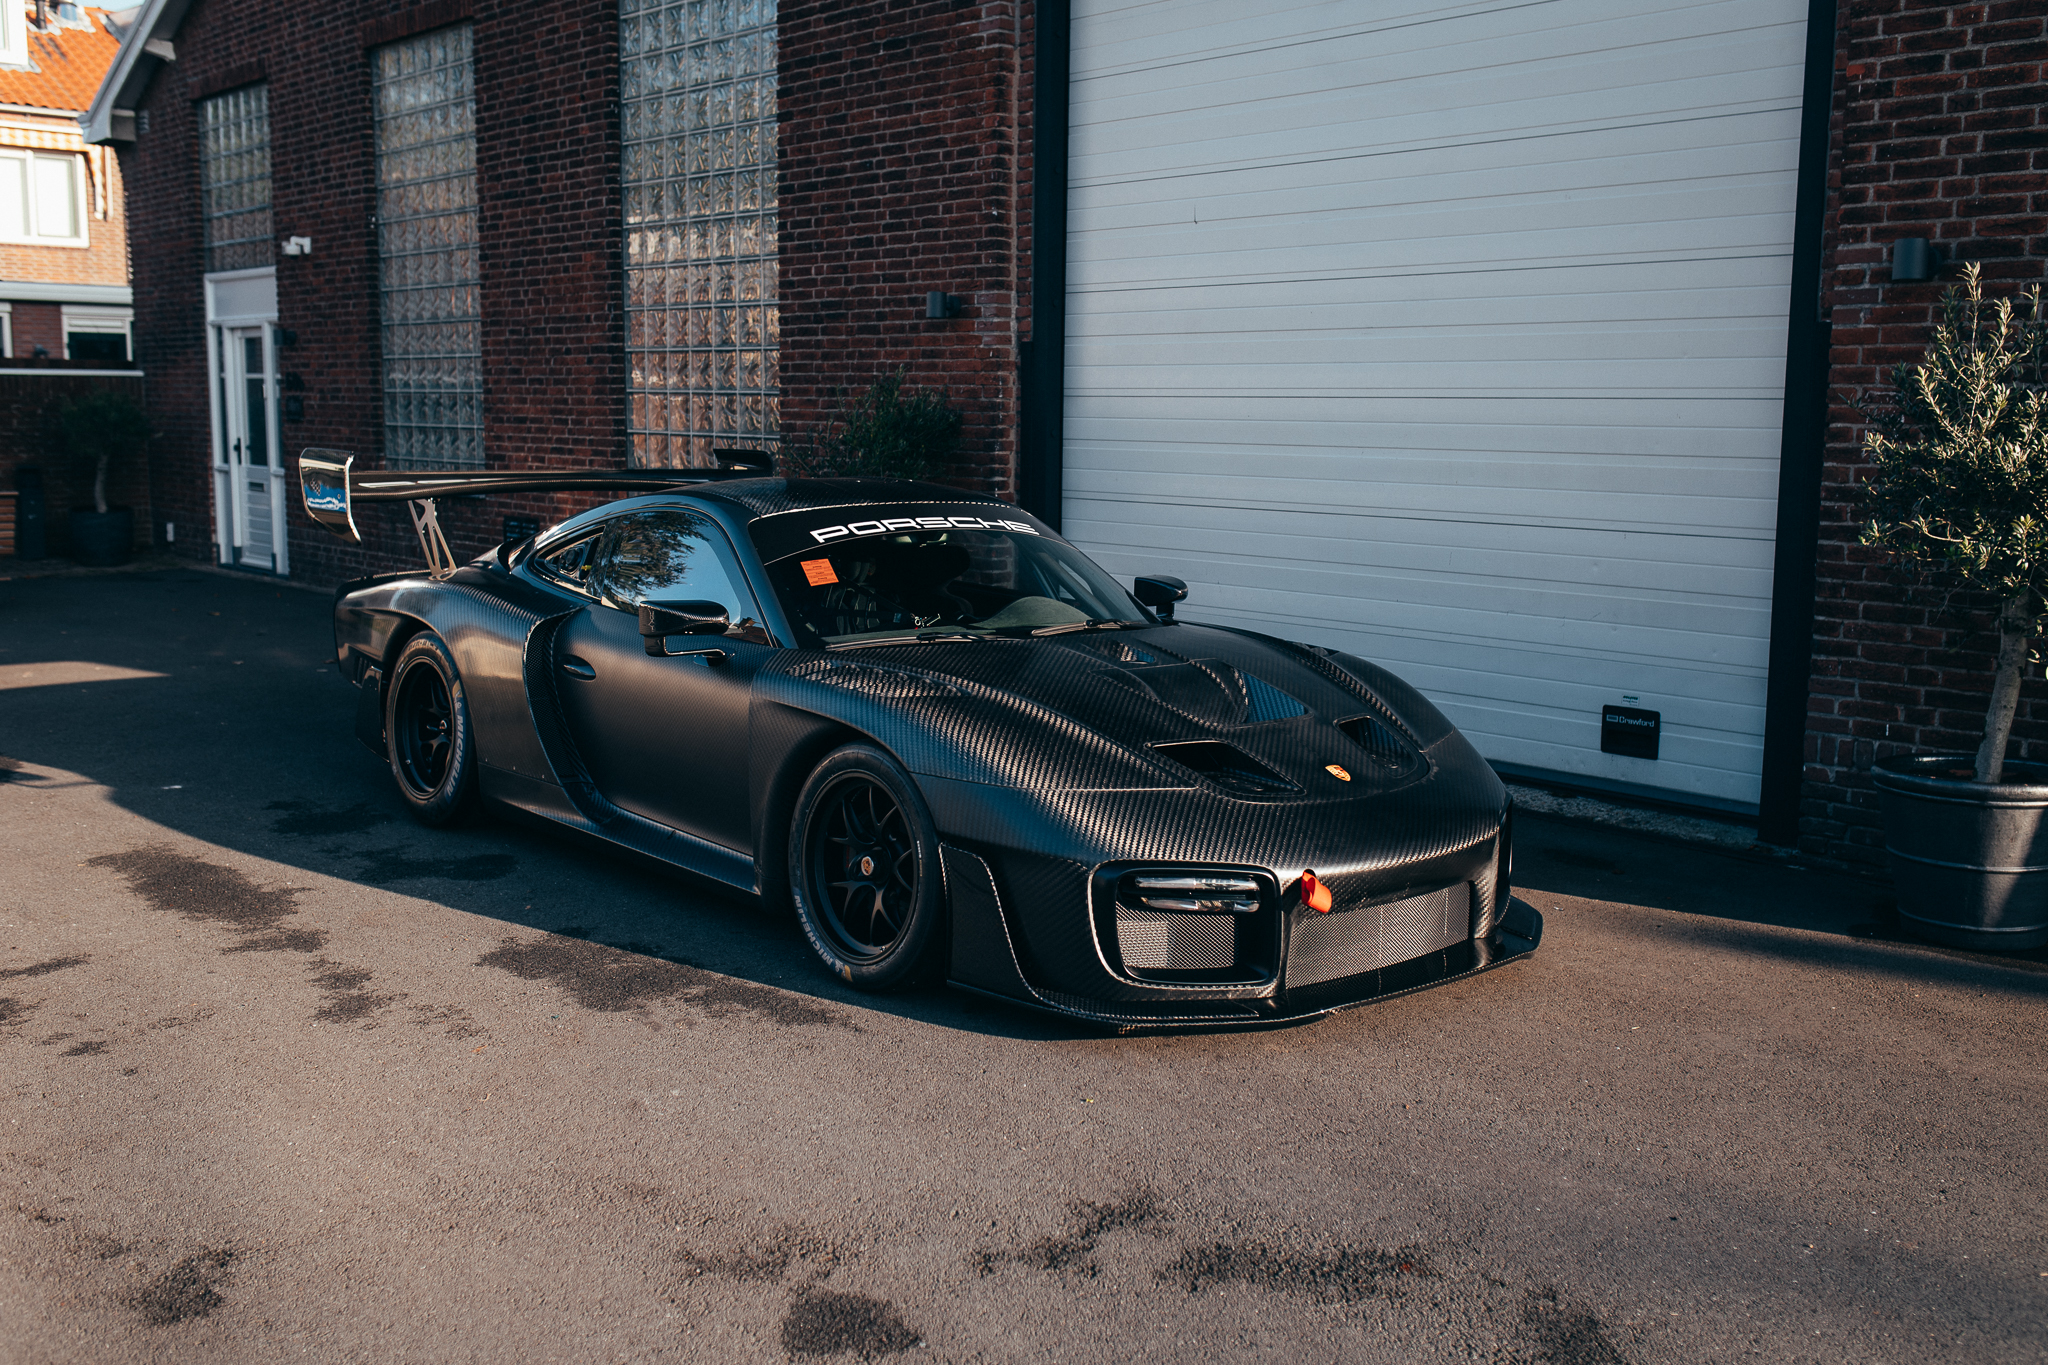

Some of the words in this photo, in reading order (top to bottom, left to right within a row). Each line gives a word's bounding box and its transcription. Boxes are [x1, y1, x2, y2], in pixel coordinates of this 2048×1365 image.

[810, 516, 1040, 543] PORSCHE
[1619, 715, 1655, 728] Crawford
[447, 714, 464, 797] MICHELIN
[794, 895, 834, 966] MICHELIN
